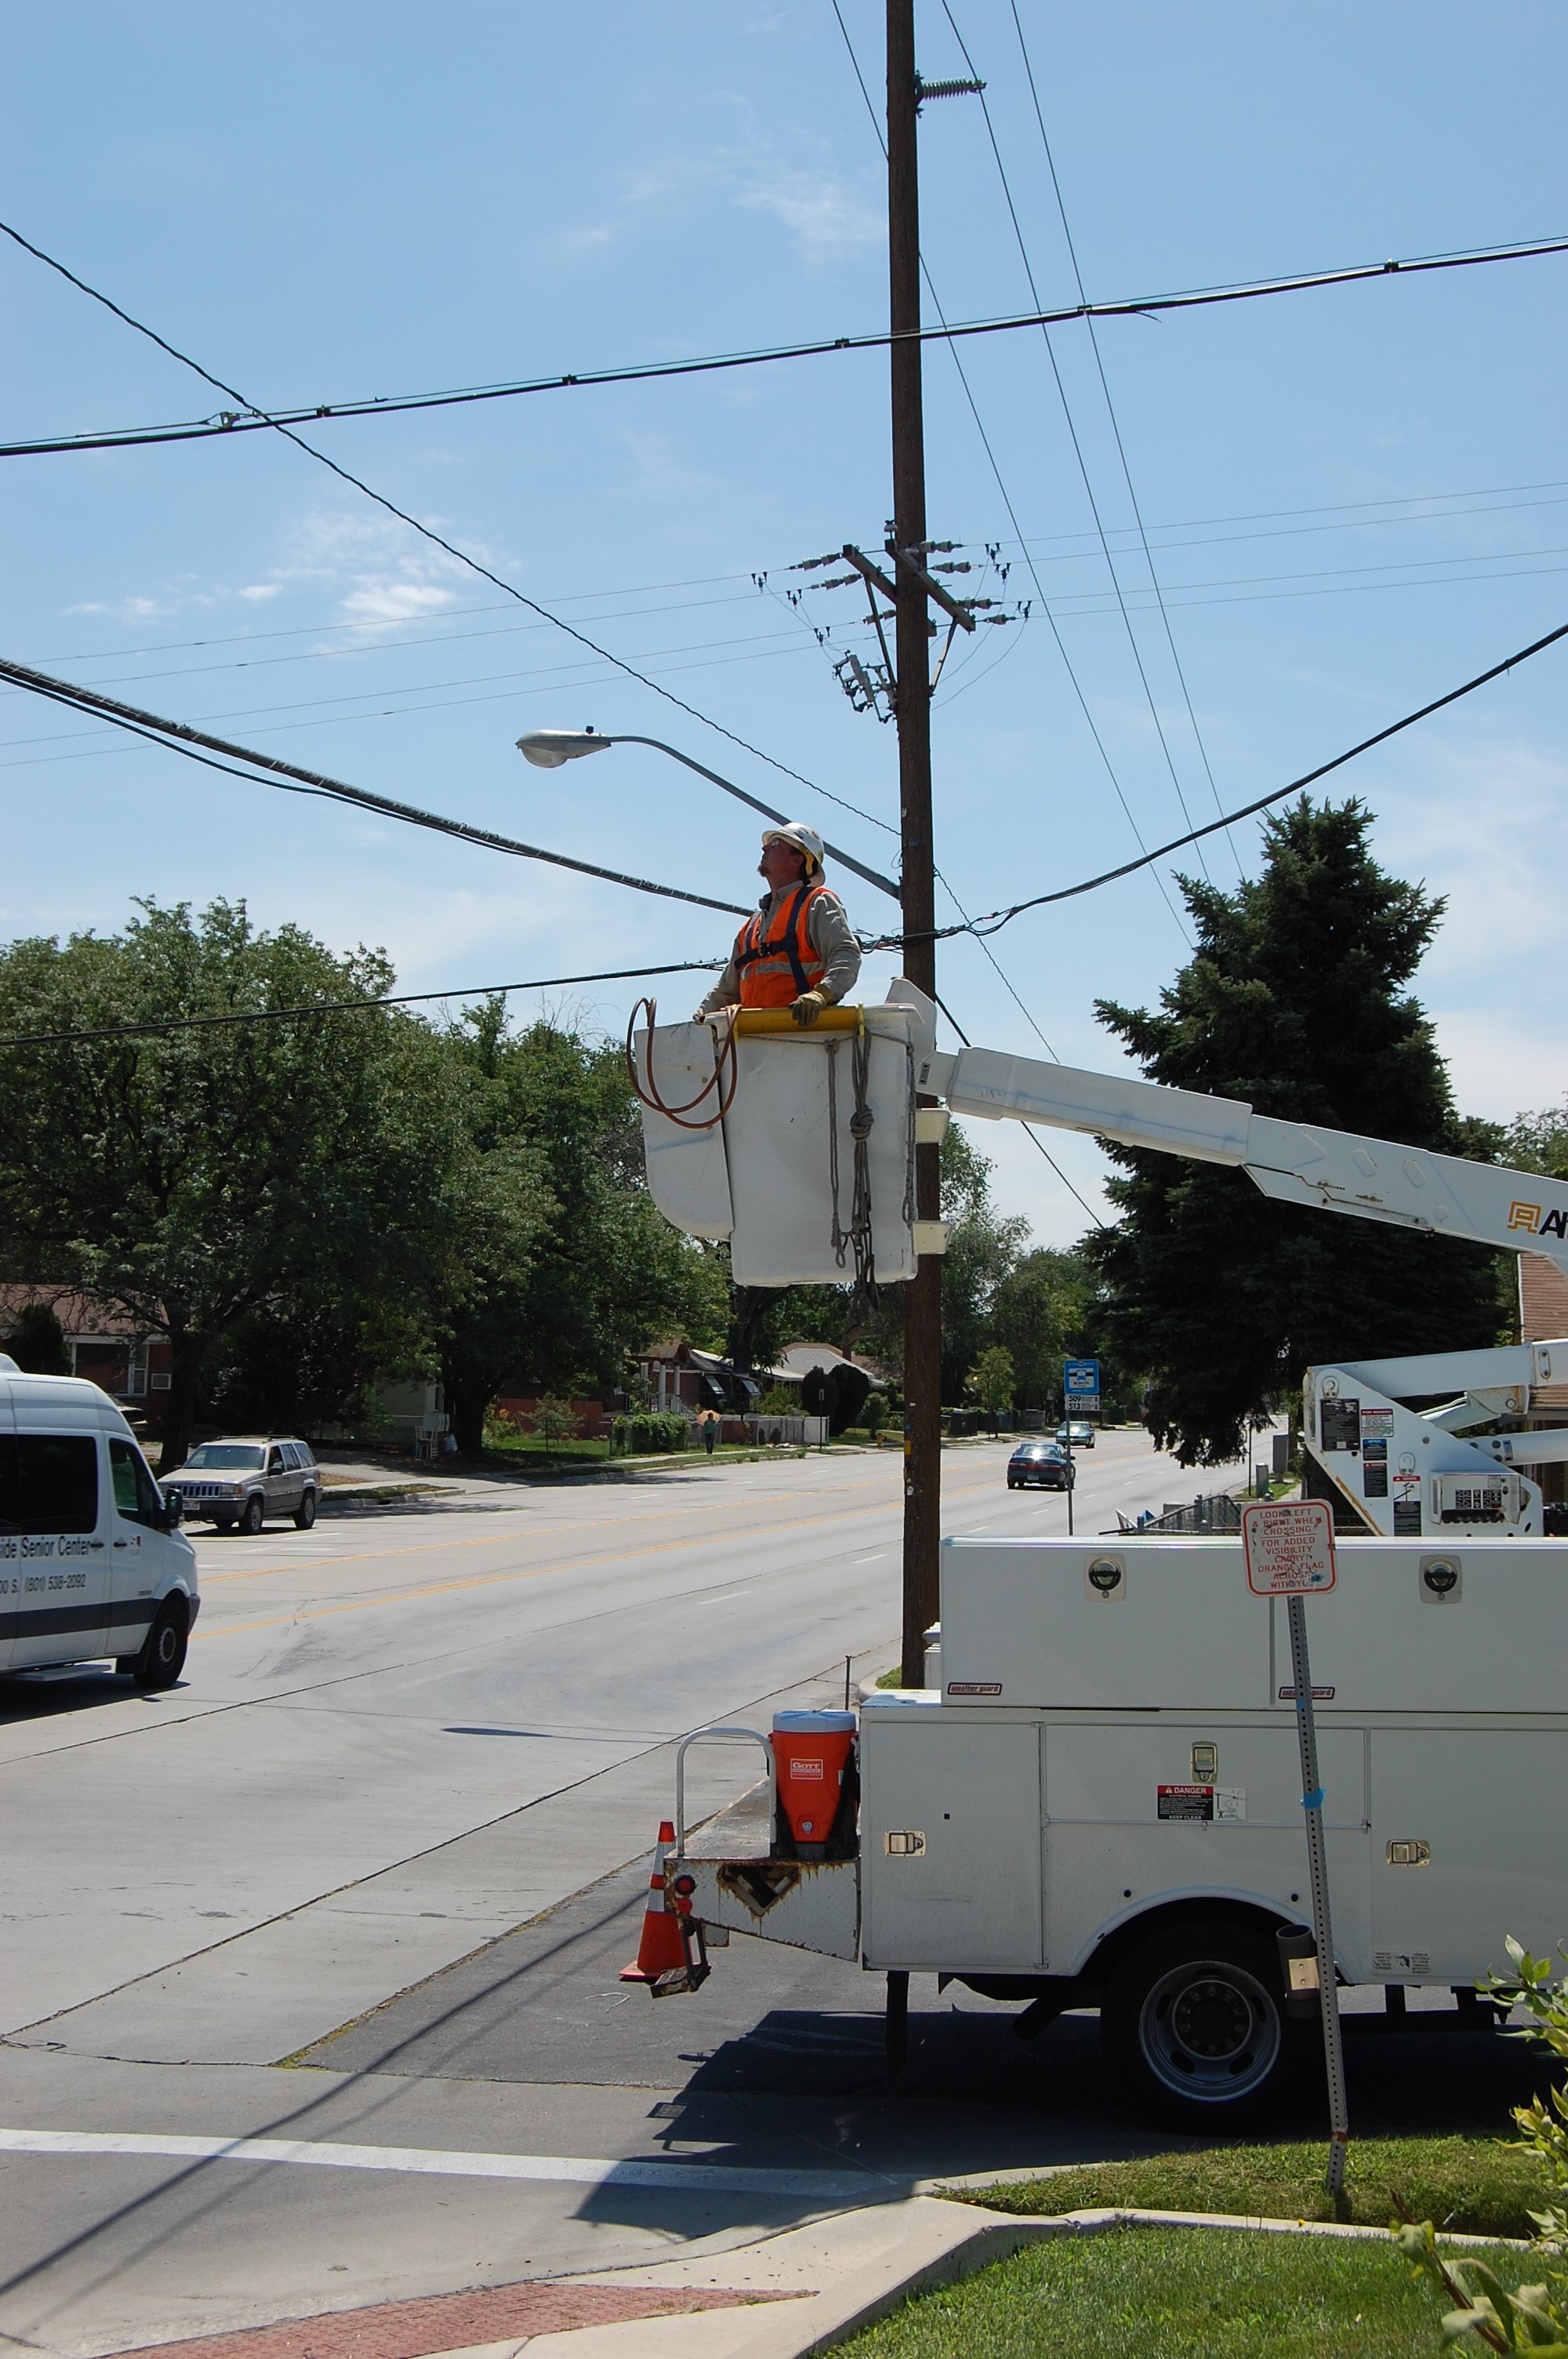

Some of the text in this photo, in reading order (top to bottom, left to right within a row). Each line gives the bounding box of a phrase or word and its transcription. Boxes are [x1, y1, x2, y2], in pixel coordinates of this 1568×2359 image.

[1260, 1510, 1286, 1518] LOOK
[1263, 1518, 1290, 1528] RIGHT
[1264, 1525, 1311, 1535] CROSSING
[1284, 1537, 1316, 1546] ADDED
[0, 1535, 90, 1559] ide Senior Center
[1265, 1546, 1312, 1554] VISIBILITY
[1274, 1554, 1305, 1563] CARRY
[1258, 1564, 1295, 1572] ORANGE
[1273, 1571, 1308, 1580] ACROS
[25, 1575, 45, 1594] (801)
